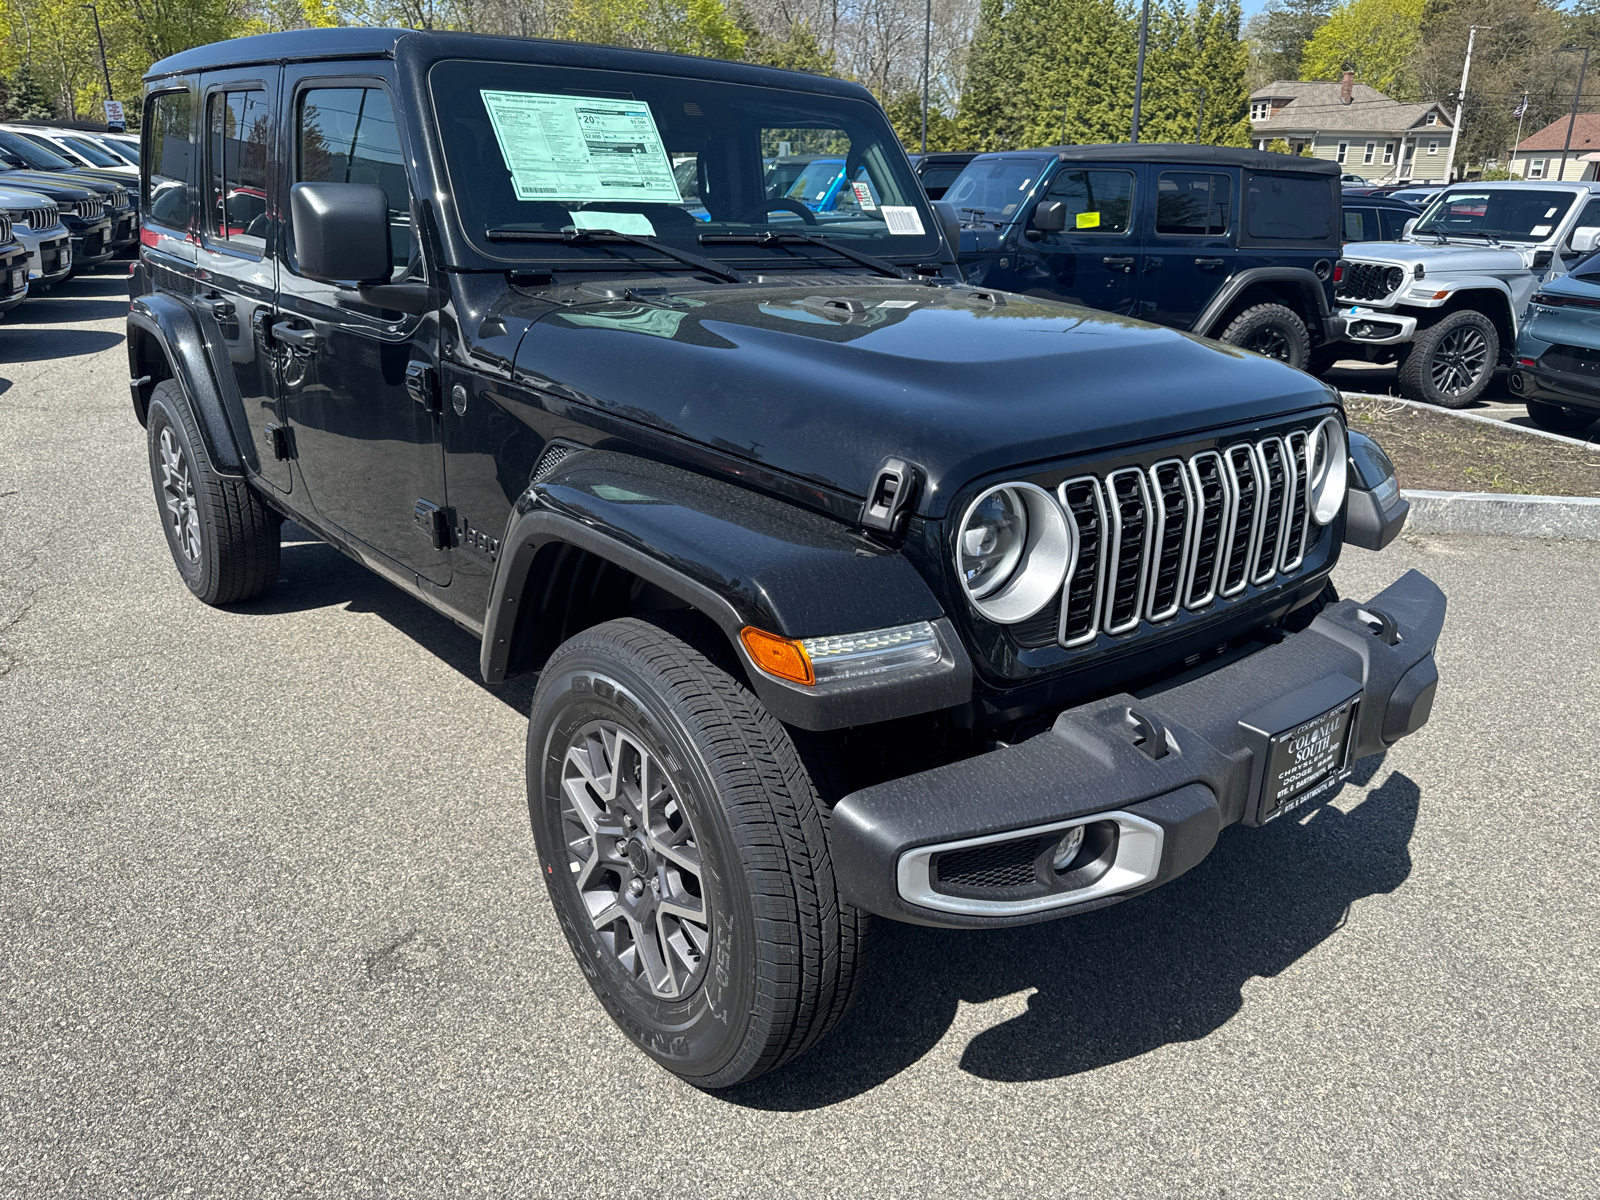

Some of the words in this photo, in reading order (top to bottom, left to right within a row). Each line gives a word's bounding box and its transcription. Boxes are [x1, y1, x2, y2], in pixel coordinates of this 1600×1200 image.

[583, 115, 595, 124] 20
[455, 516, 500, 562] Jeep
[1288, 717, 1341, 754] COLONIAL
[1295, 735, 1331, 764] SOUTH
[1278, 752, 1325, 780] CHRYSLER
[1328, 742, 1340, 754] Jeep
[1283, 767, 1313, 786] DODGE
[1317, 754, 1333, 767] RAM
